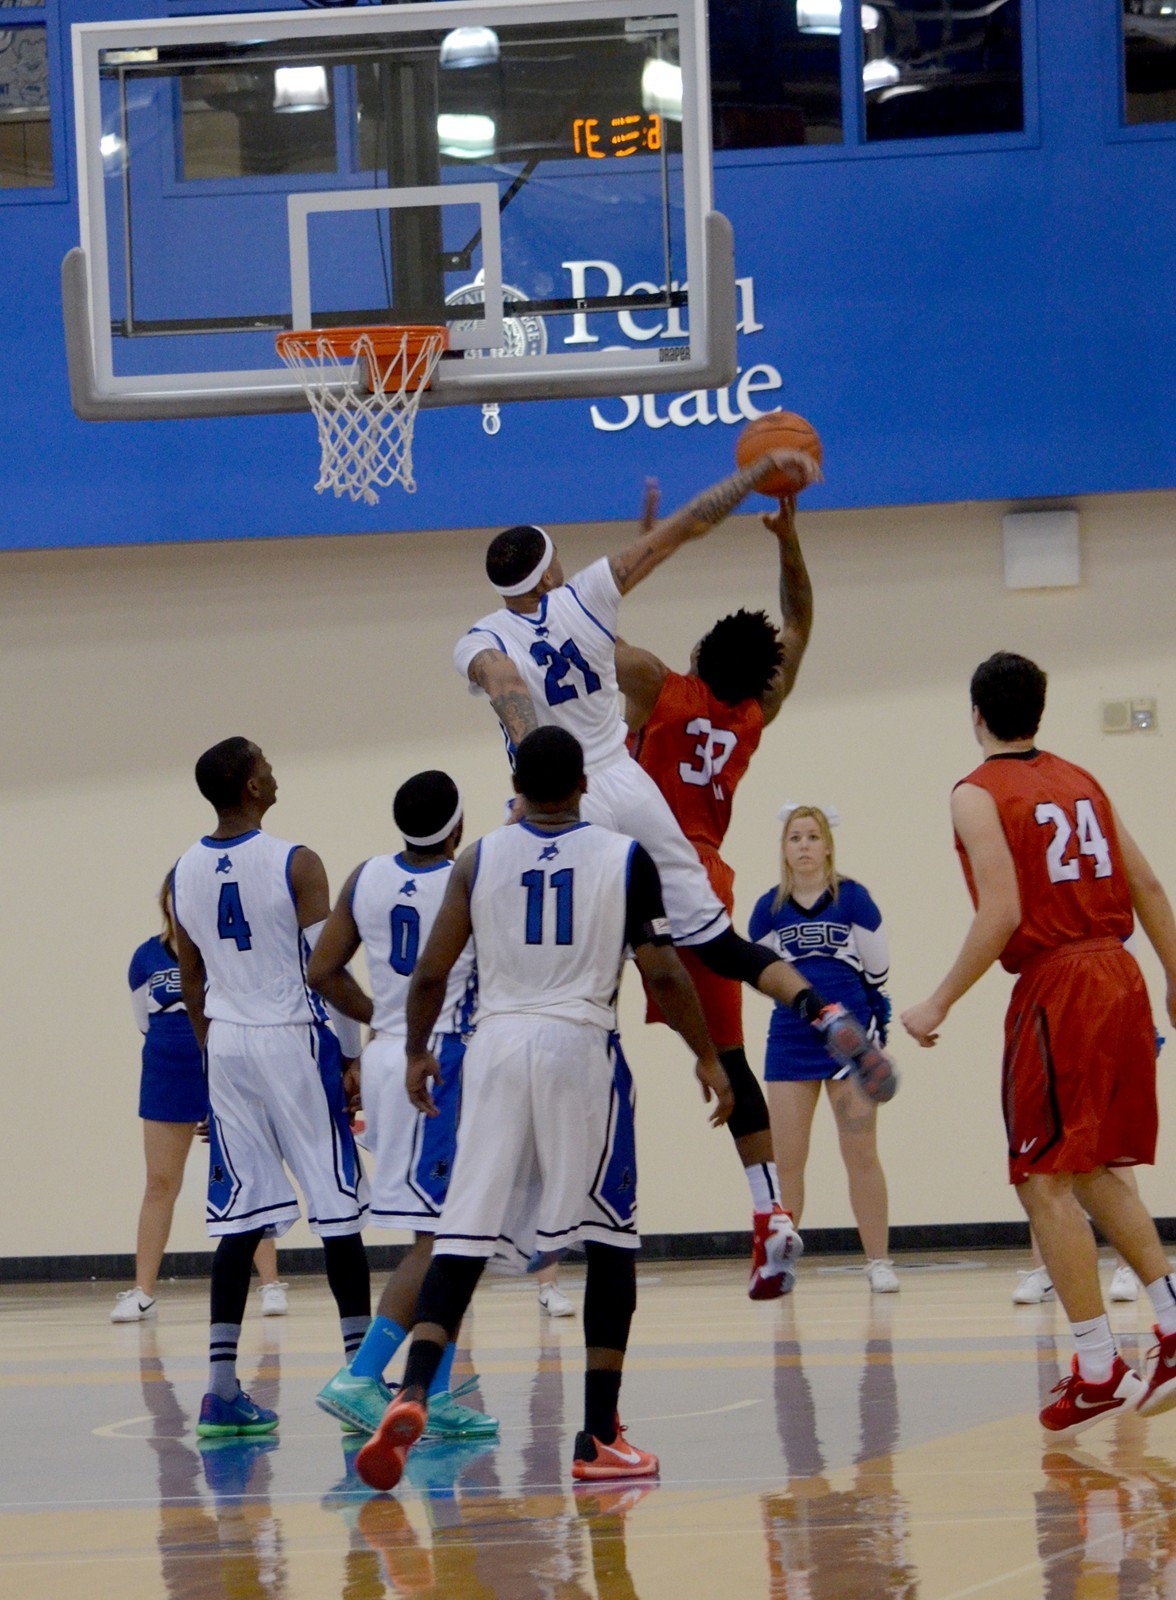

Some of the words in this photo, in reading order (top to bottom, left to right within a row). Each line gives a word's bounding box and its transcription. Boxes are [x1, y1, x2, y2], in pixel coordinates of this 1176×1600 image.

[529, 638, 602, 706] 21
[1034, 798, 1112, 884] 24
[217, 881, 252, 951] 4
[389, 904, 420, 977] 0
[521, 867, 574, 945] 11
[777, 921, 850, 951] PSC
